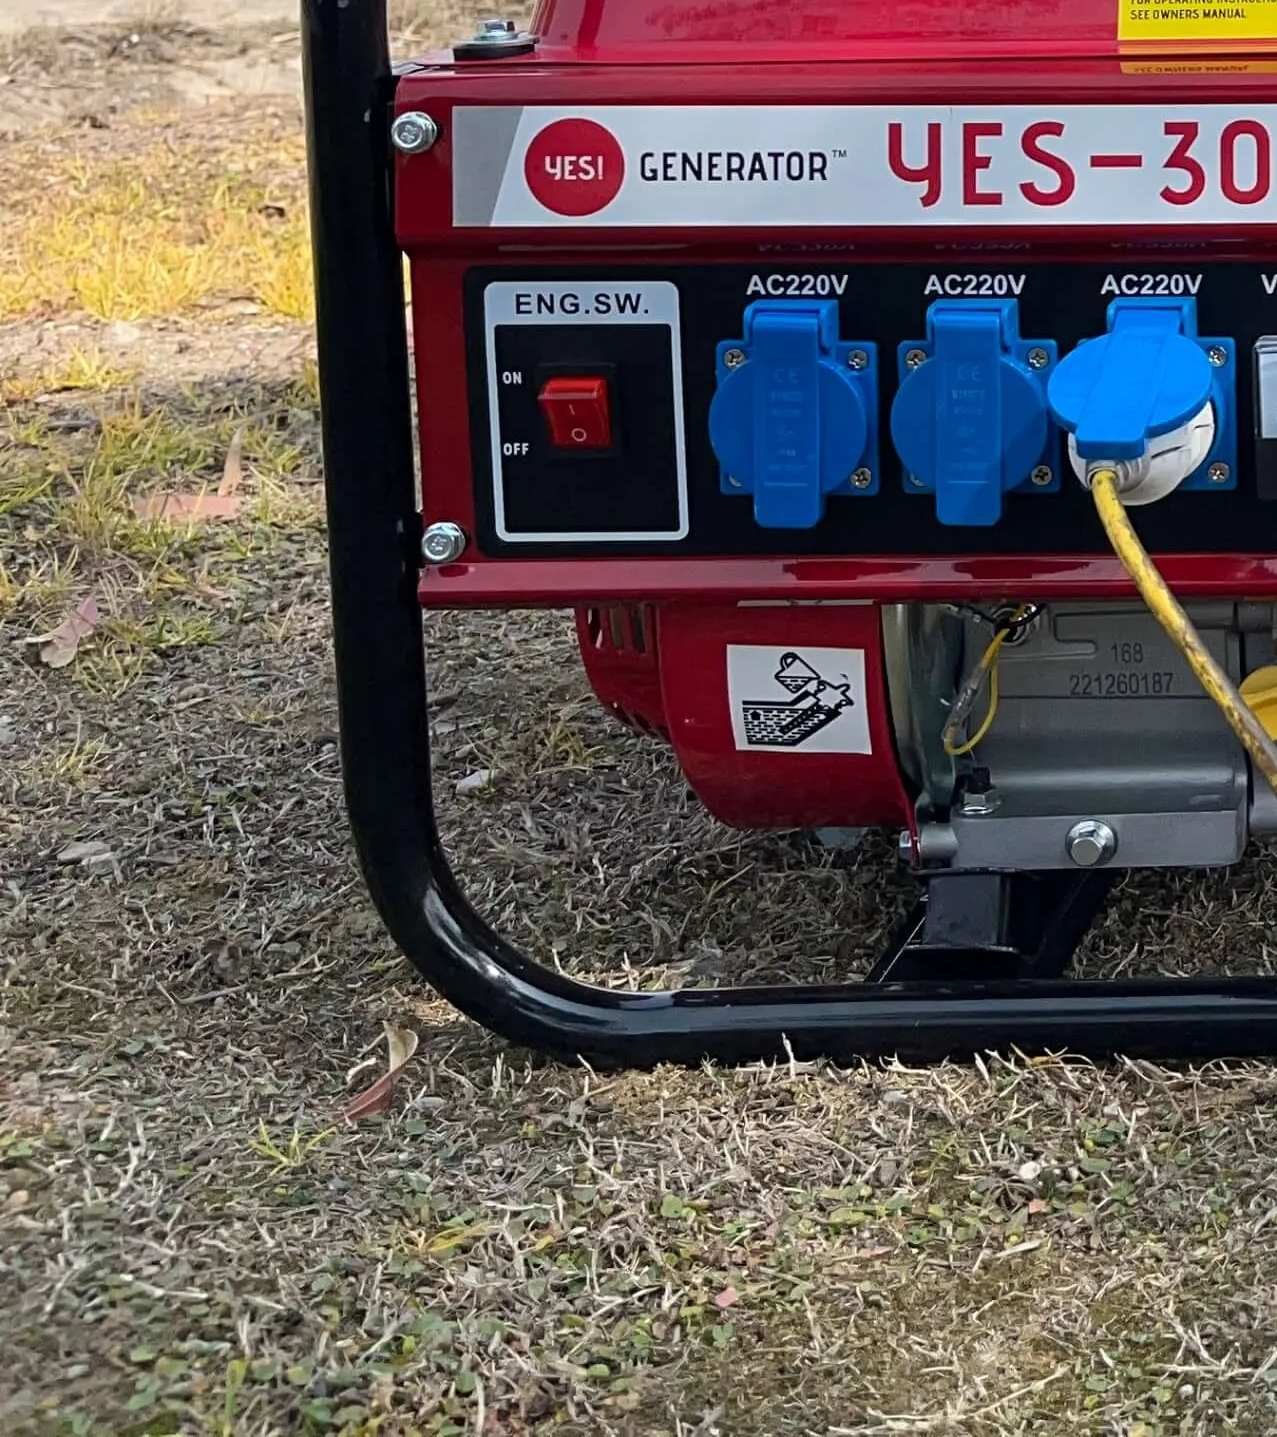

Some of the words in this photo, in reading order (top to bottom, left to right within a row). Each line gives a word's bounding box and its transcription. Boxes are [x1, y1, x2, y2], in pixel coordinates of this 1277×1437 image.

[1130, 9, 1150, 20] SEE
[1152, 9, 1199, 19] OWNERS
[1202, 7, 1247, 19] MANUAL
[544, 155, 605, 181] YES!
[746, 274, 849, 296] AC220V
[923, 273, 1026, 295] AC220V
[1100, 273, 1203, 295] AC220V
[514, 292, 650, 315] ENG.SW.
[502, 371, 523, 385] ON
[503, 443, 530, 457] OFF
[1111, 642, 1144, 664] 168
[1068, 672, 1174, 696] 221260187
